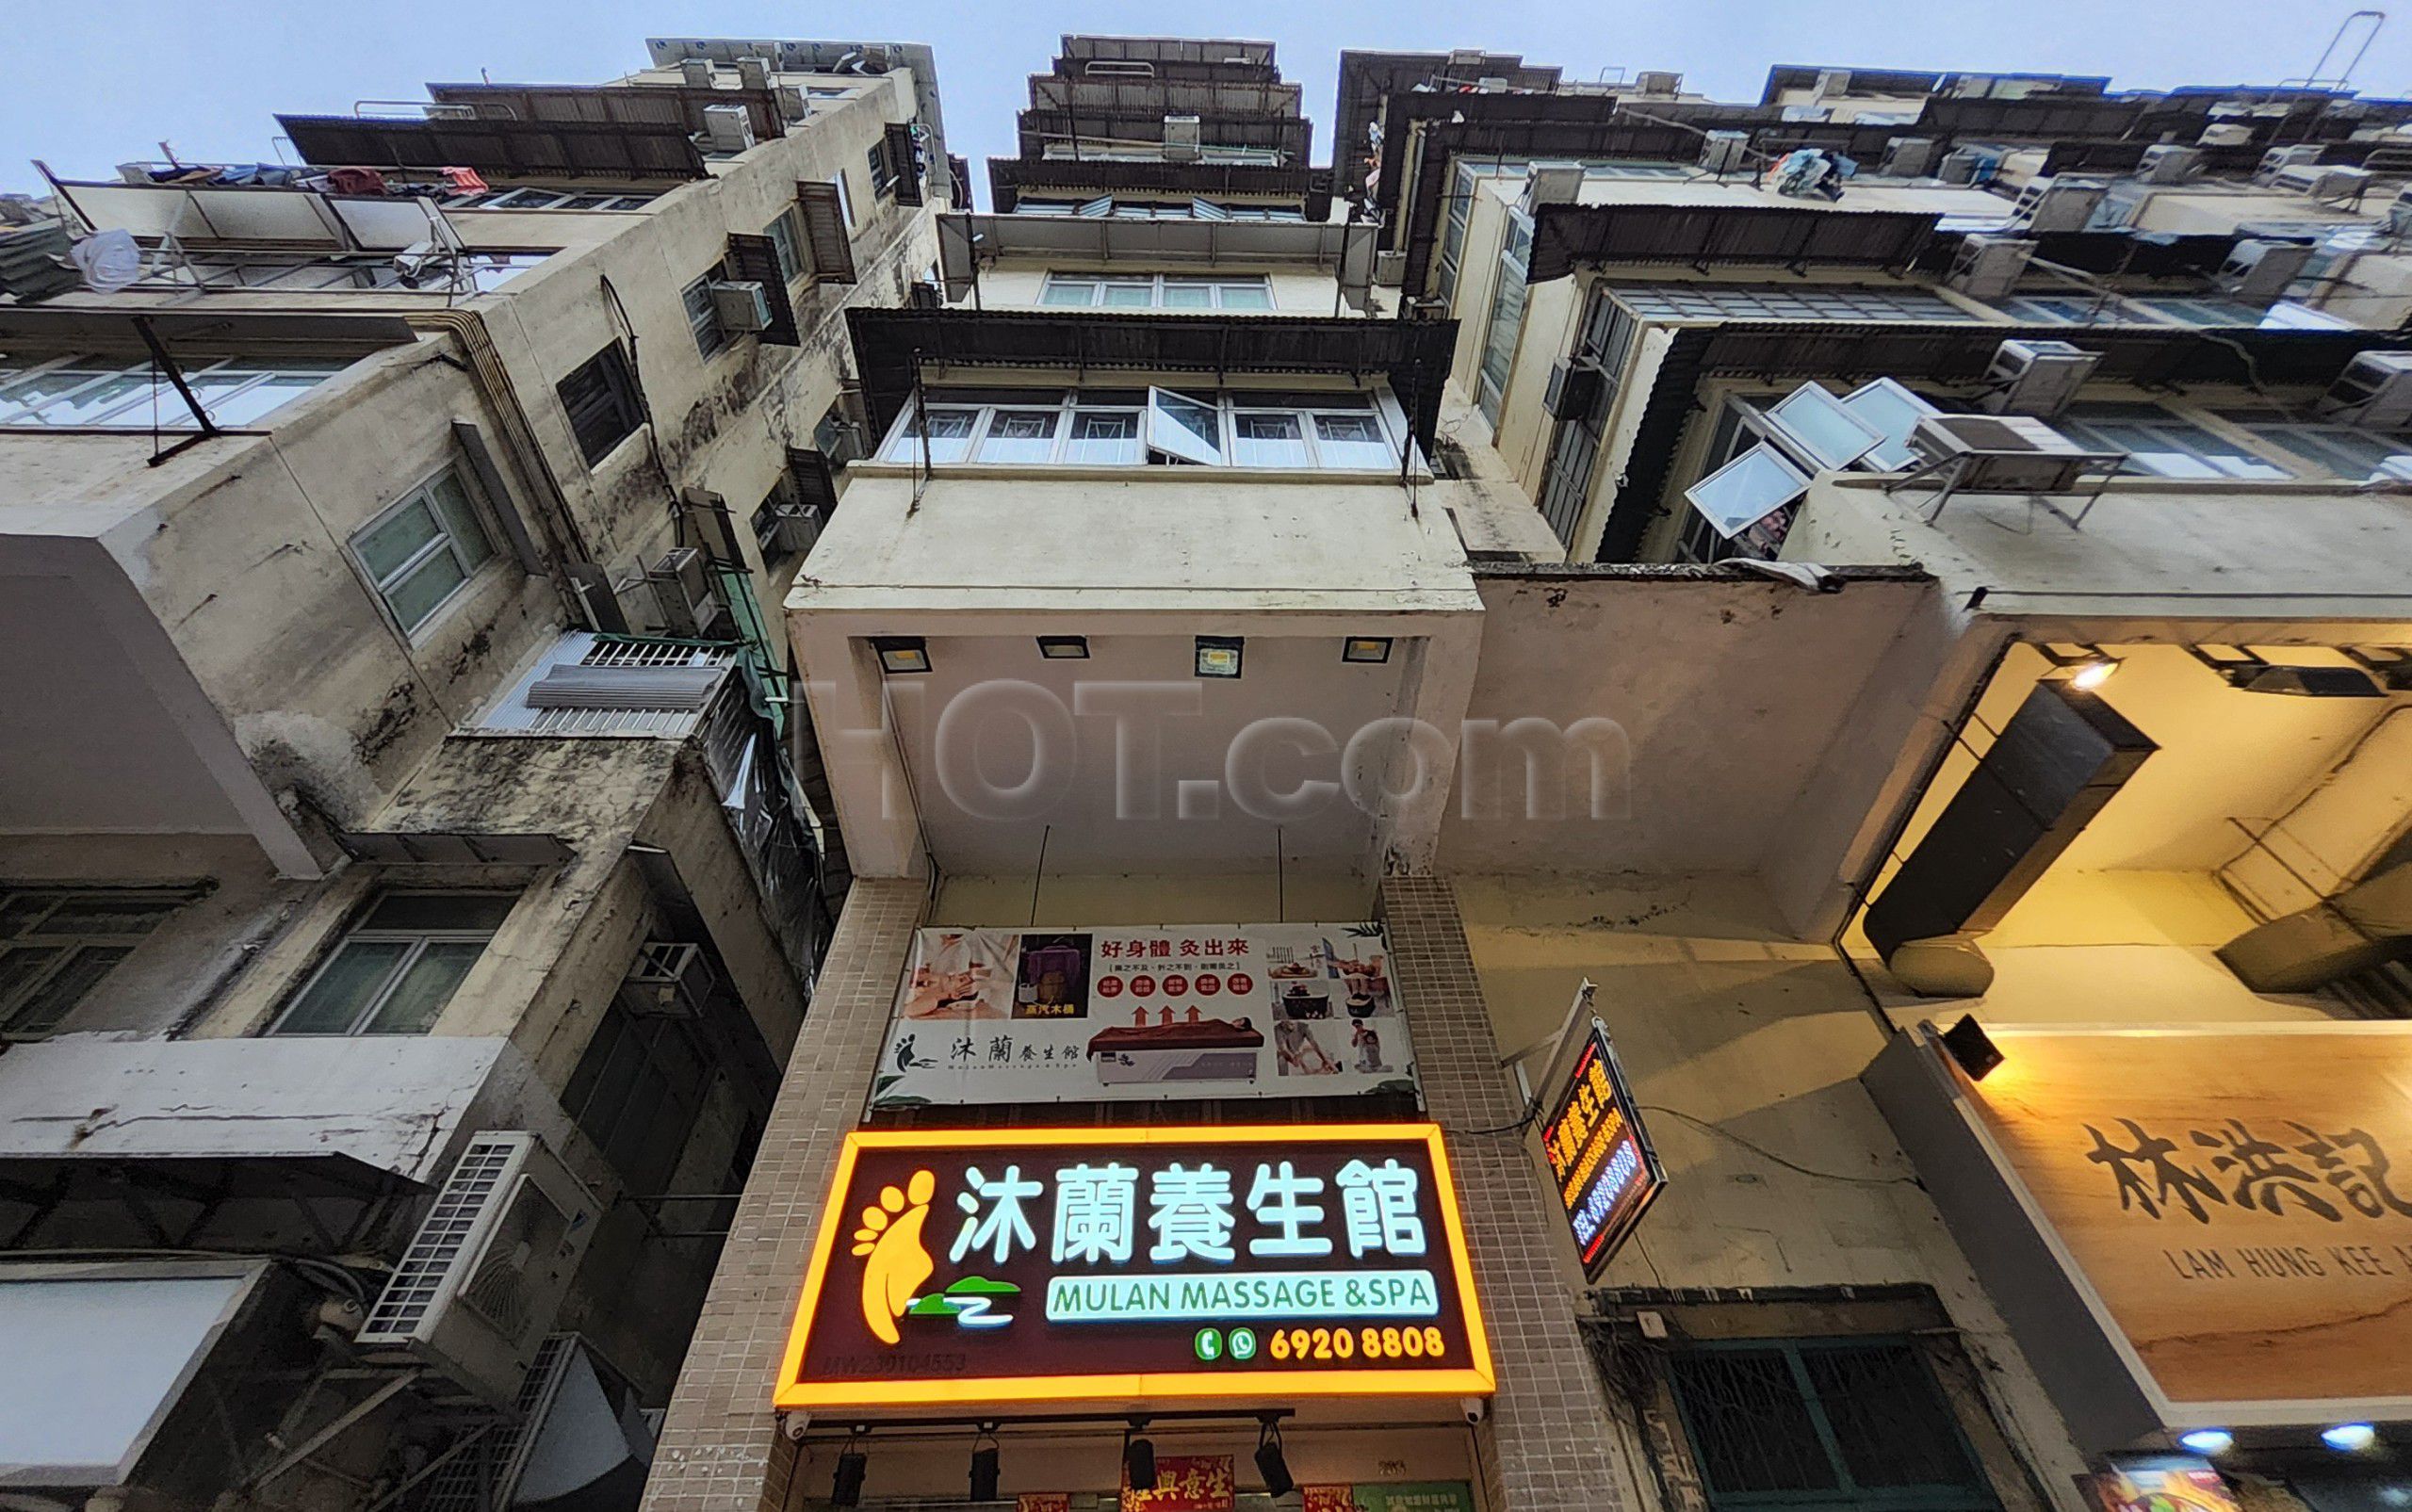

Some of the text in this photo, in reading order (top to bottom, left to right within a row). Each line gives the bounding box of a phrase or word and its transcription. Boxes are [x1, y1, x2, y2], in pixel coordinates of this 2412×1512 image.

[2081, 1116, 2412, 1225] 林洪記
[949, 1160, 1426, 1264] 沐蘭養生館
[2161, 1248, 2237, 1280] LAM
[2235, 1245, 2327, 1278] HUNG
[2324, 1245, 2395, 1276] KEE
[1052, 1276, 1431, 1312] MULAN MASSAGE &SPA
[1269, 1326, 1445, 1360] 6920 8808
